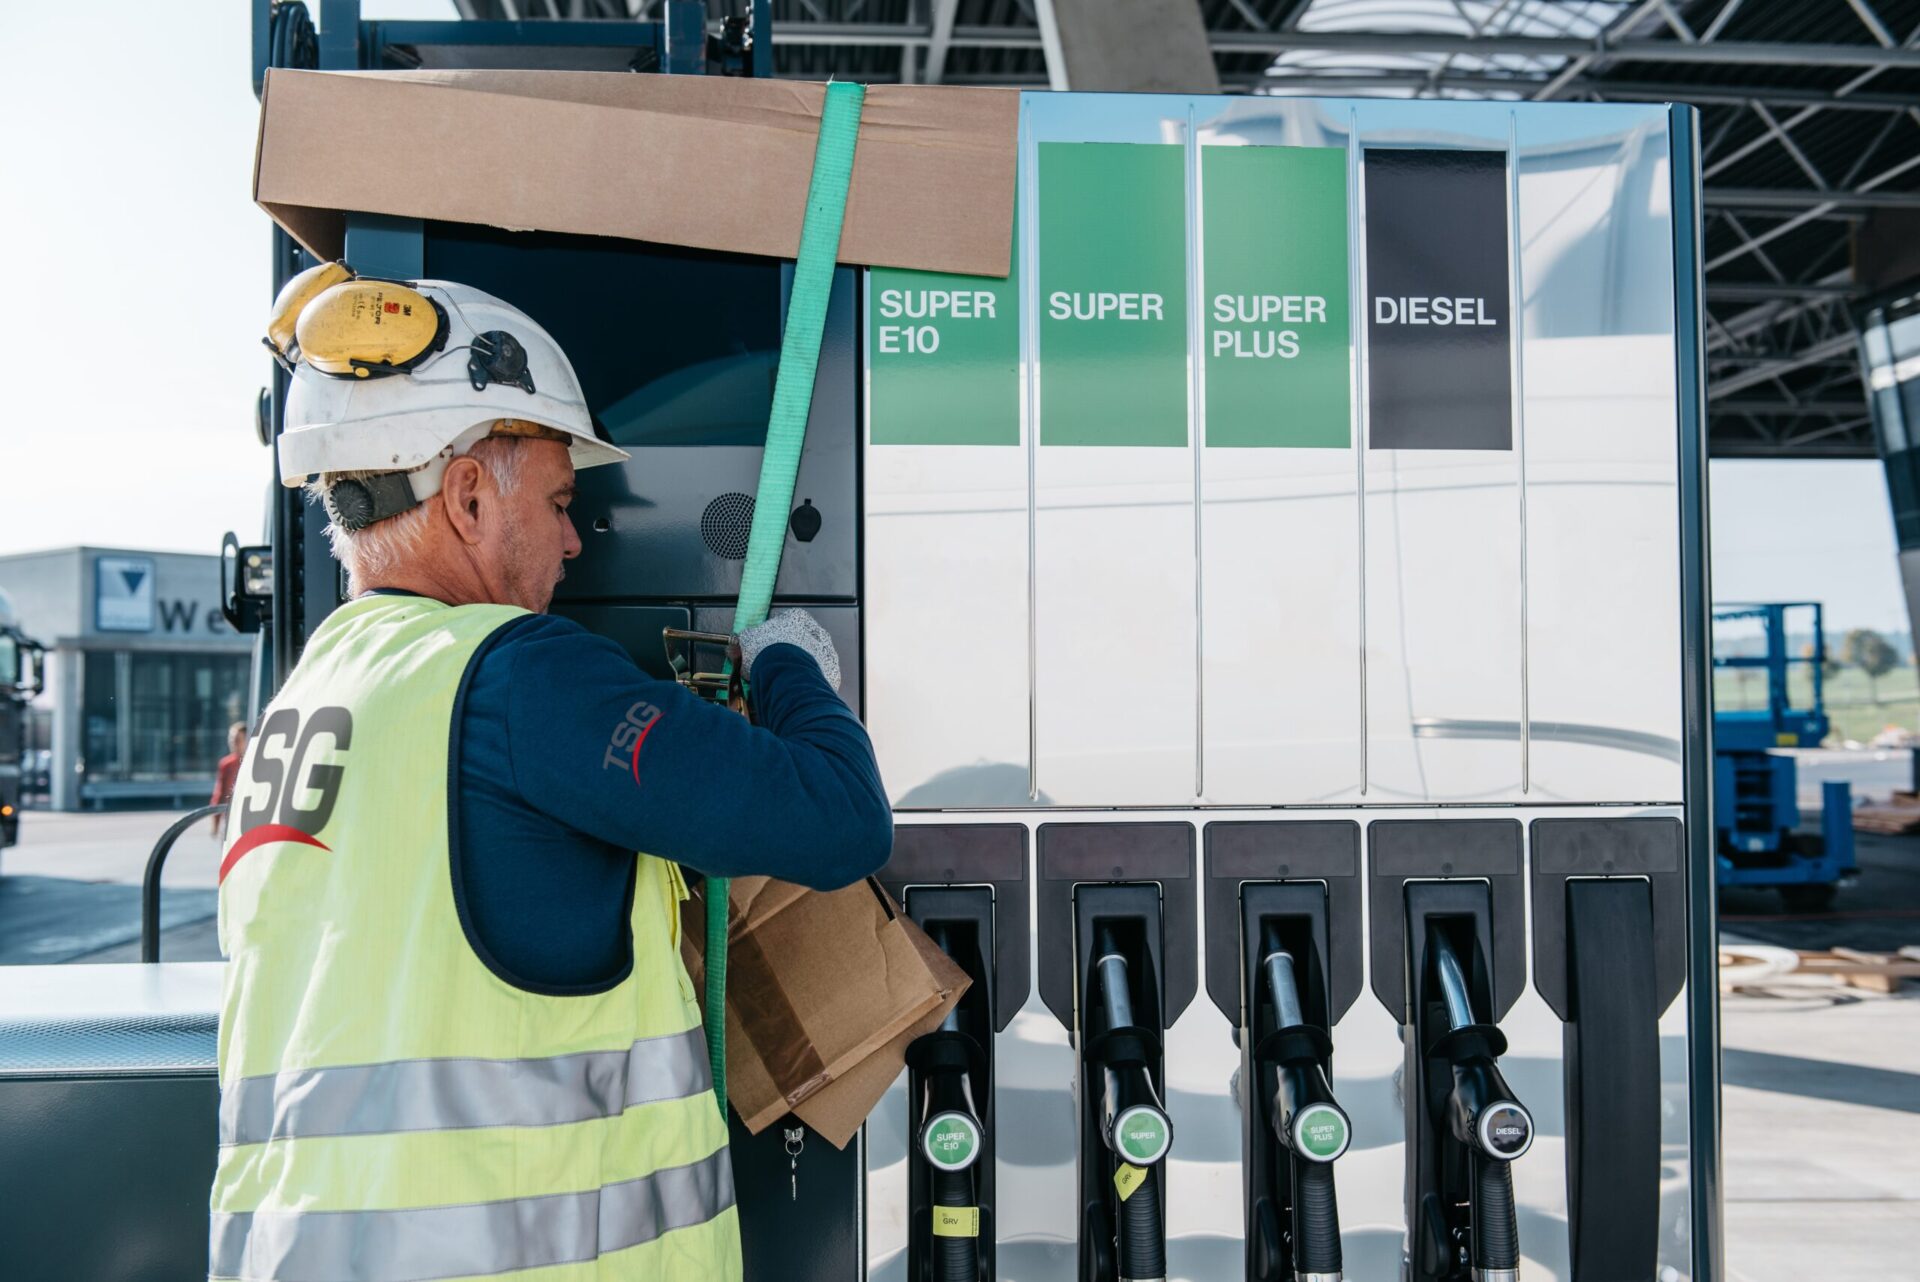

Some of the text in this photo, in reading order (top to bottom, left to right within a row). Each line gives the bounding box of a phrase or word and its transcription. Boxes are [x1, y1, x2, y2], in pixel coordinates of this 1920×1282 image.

[403, 304, 412, 316] 3M
[880, 290, 996, 318] SUPER
[1049, 292, 1163, 320] SUPER
[1213, 294, 1326, 323] SUPER
[1375, 296, 1497, 325] DIESEL
[879, 325, 940, 353] E10
[1213, 330, 1300, 358] PLUS
[603, 701, 661, 771] TSG
[226, 706, 354, 841] SG
[937, 1132, 966, 1142] SUPER
[1130, 1131, 1156, 1140] SUPER
[1310, 1125, 1335, 1134] SUPER
[1314, 1133, 1334, 1142] PLUS
[1495, 1127, 1521, 1135] DIESEL
[943, 1142, 959, 1151] E10
[943, 1217, 959, 1226] GRV
